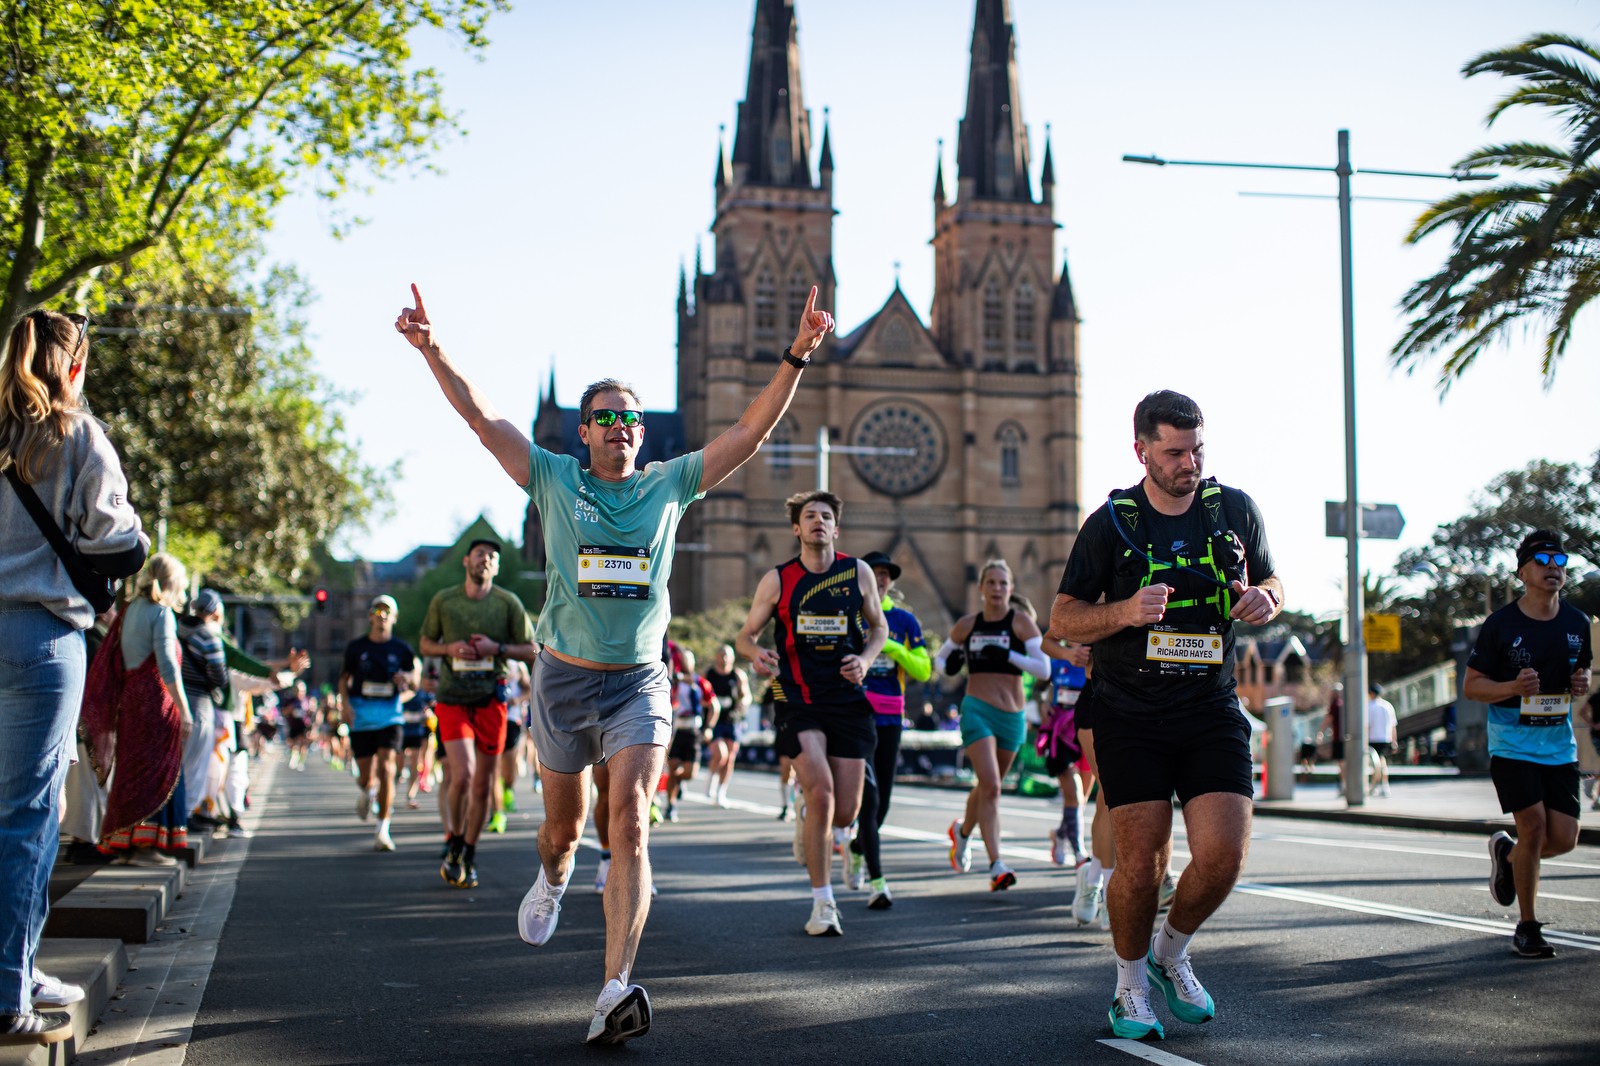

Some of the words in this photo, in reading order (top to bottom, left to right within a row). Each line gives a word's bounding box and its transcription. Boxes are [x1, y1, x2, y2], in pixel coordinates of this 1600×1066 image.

[574, 510, 598, 523] SYD
[597, 559, 632, 569] B23710
[1567, 633, 1580, 642] tcs
[1168, 638, 1204, 648] B21350
[1157, 648, 1189, 658] RICHARD
[1190, 650, 1213, 659] HAYES
